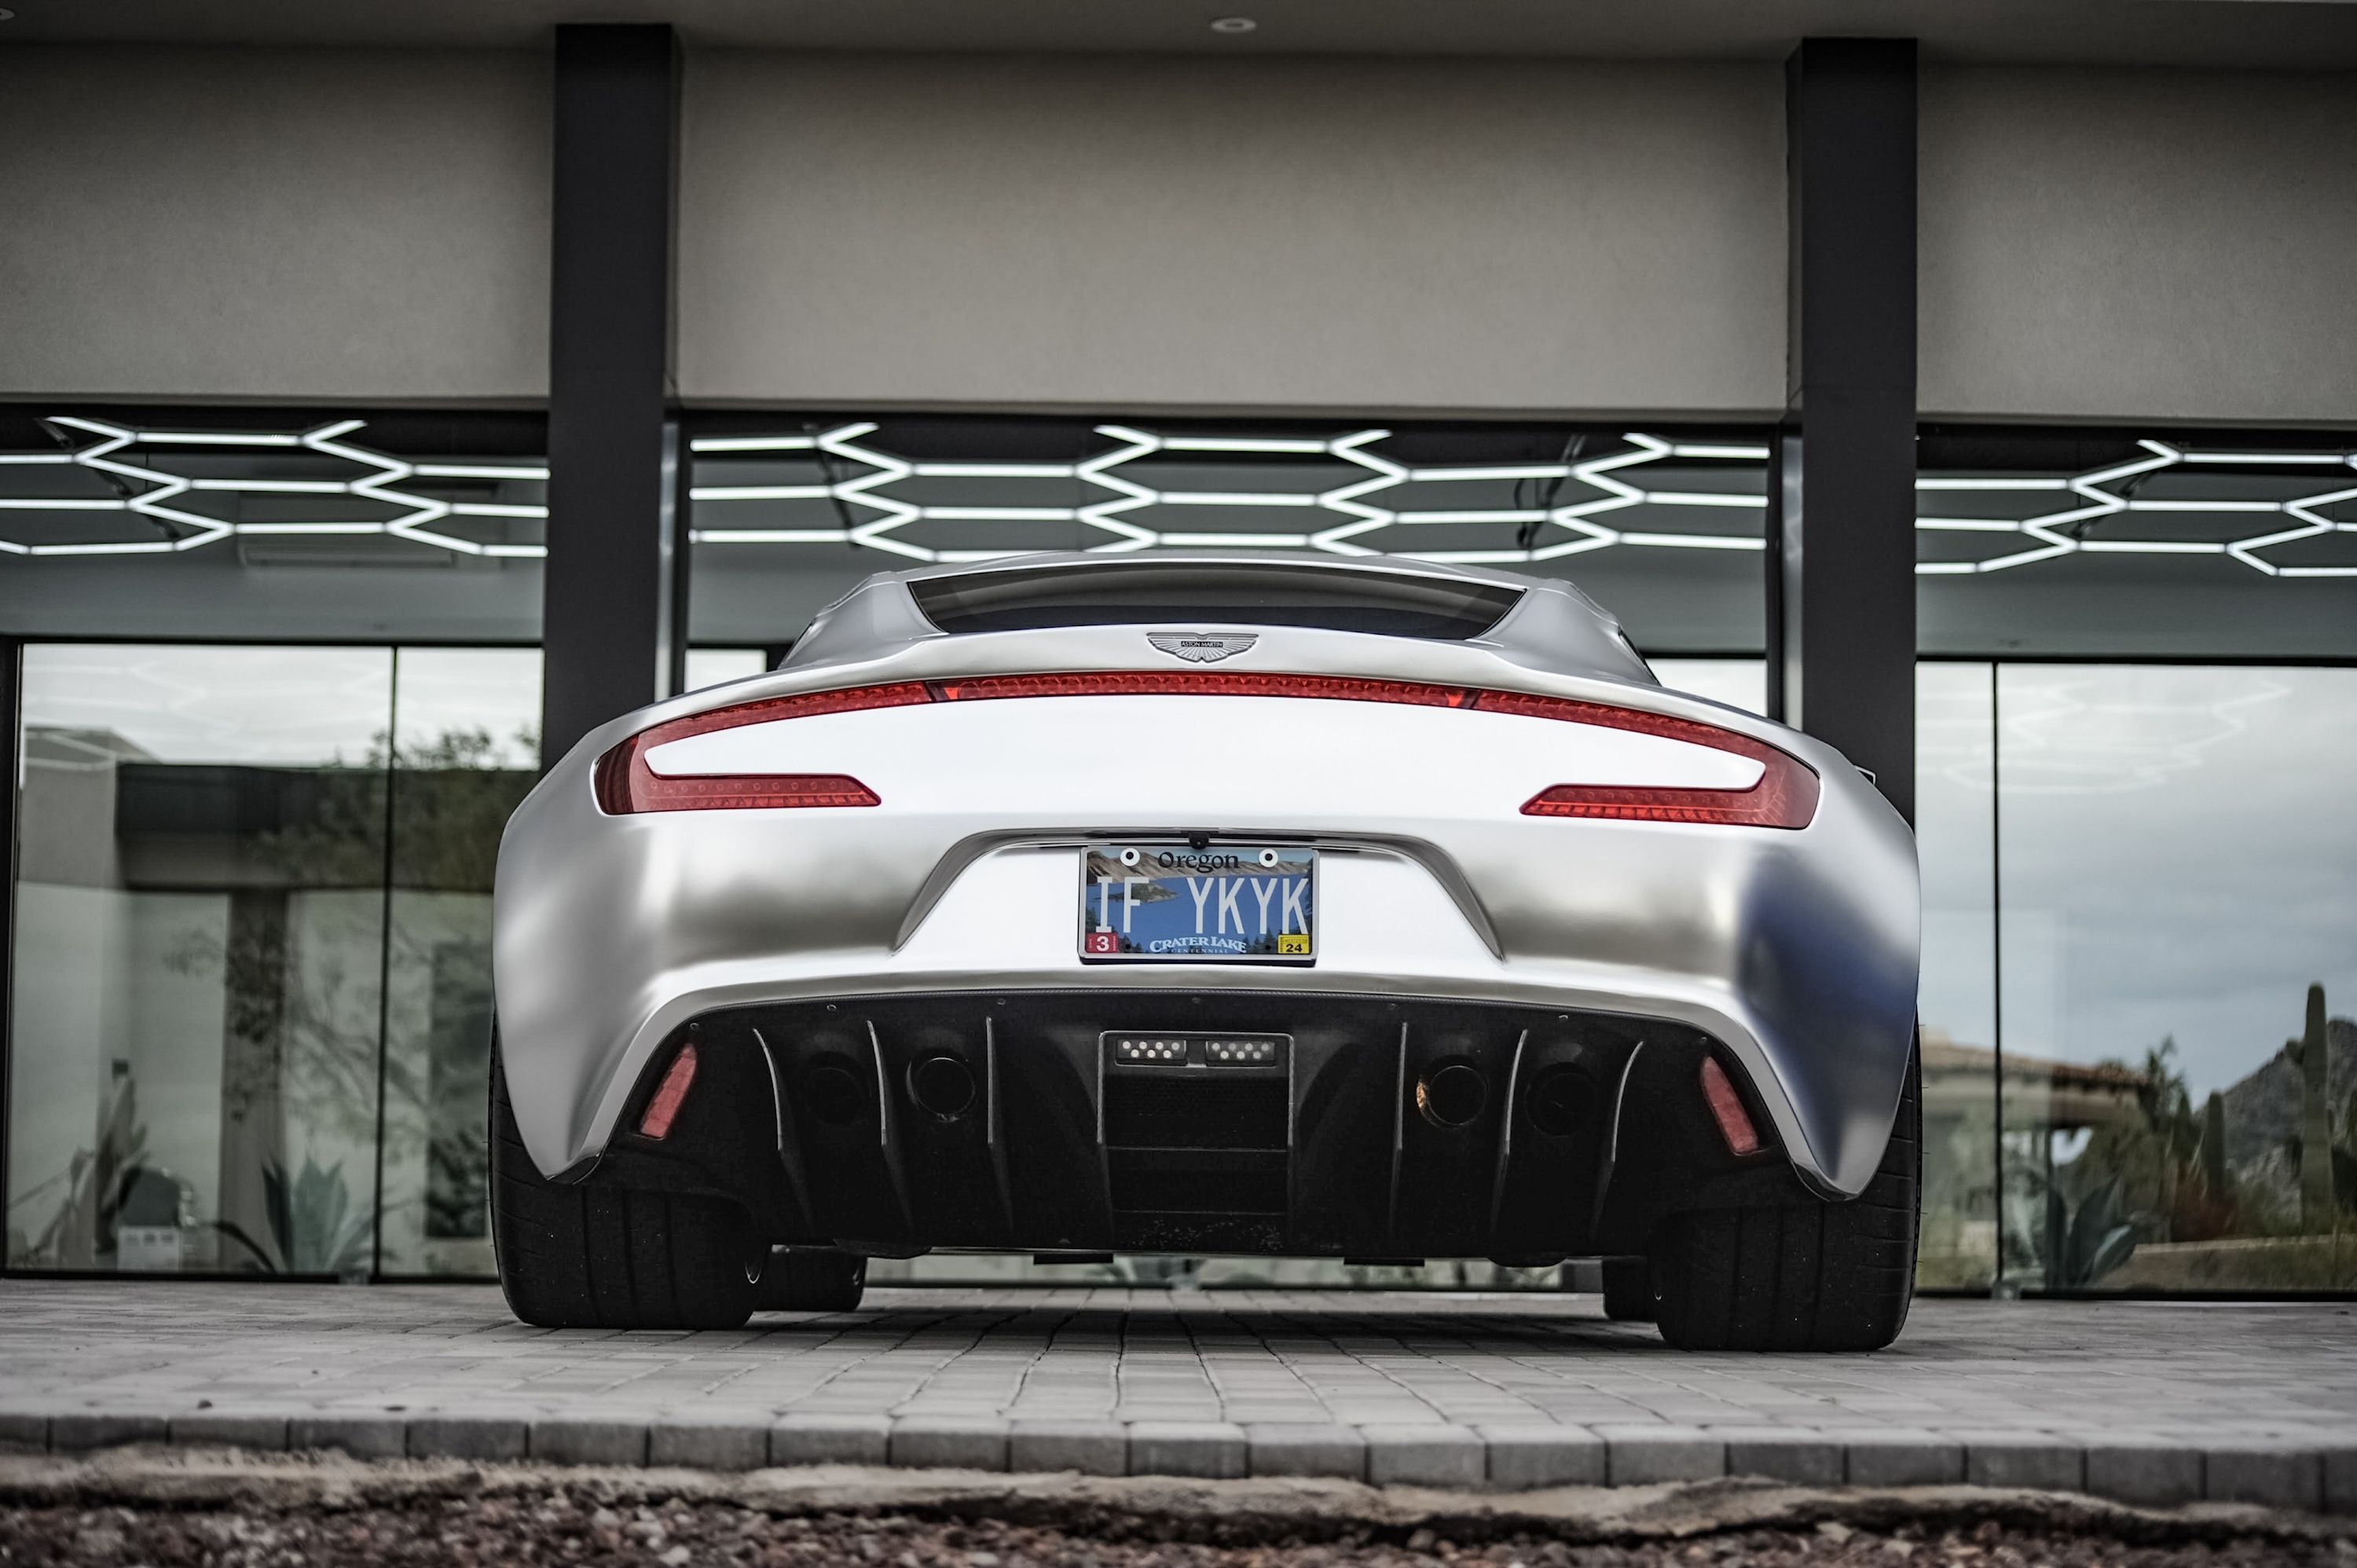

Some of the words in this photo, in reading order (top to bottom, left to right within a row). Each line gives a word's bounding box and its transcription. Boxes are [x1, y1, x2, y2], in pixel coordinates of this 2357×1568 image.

[1158, 852, 1240, 873] Oregon
[1095, 877, 1149, 933] IF
[1186, 877, 1310, 934] YKYK
[1096, 936, 1109, 951] 3
[1149, 936, 1209, 953] CRATER
[1211, 936, 1247, 953] LAKE
[1285, 943, 1303, 953] 24
